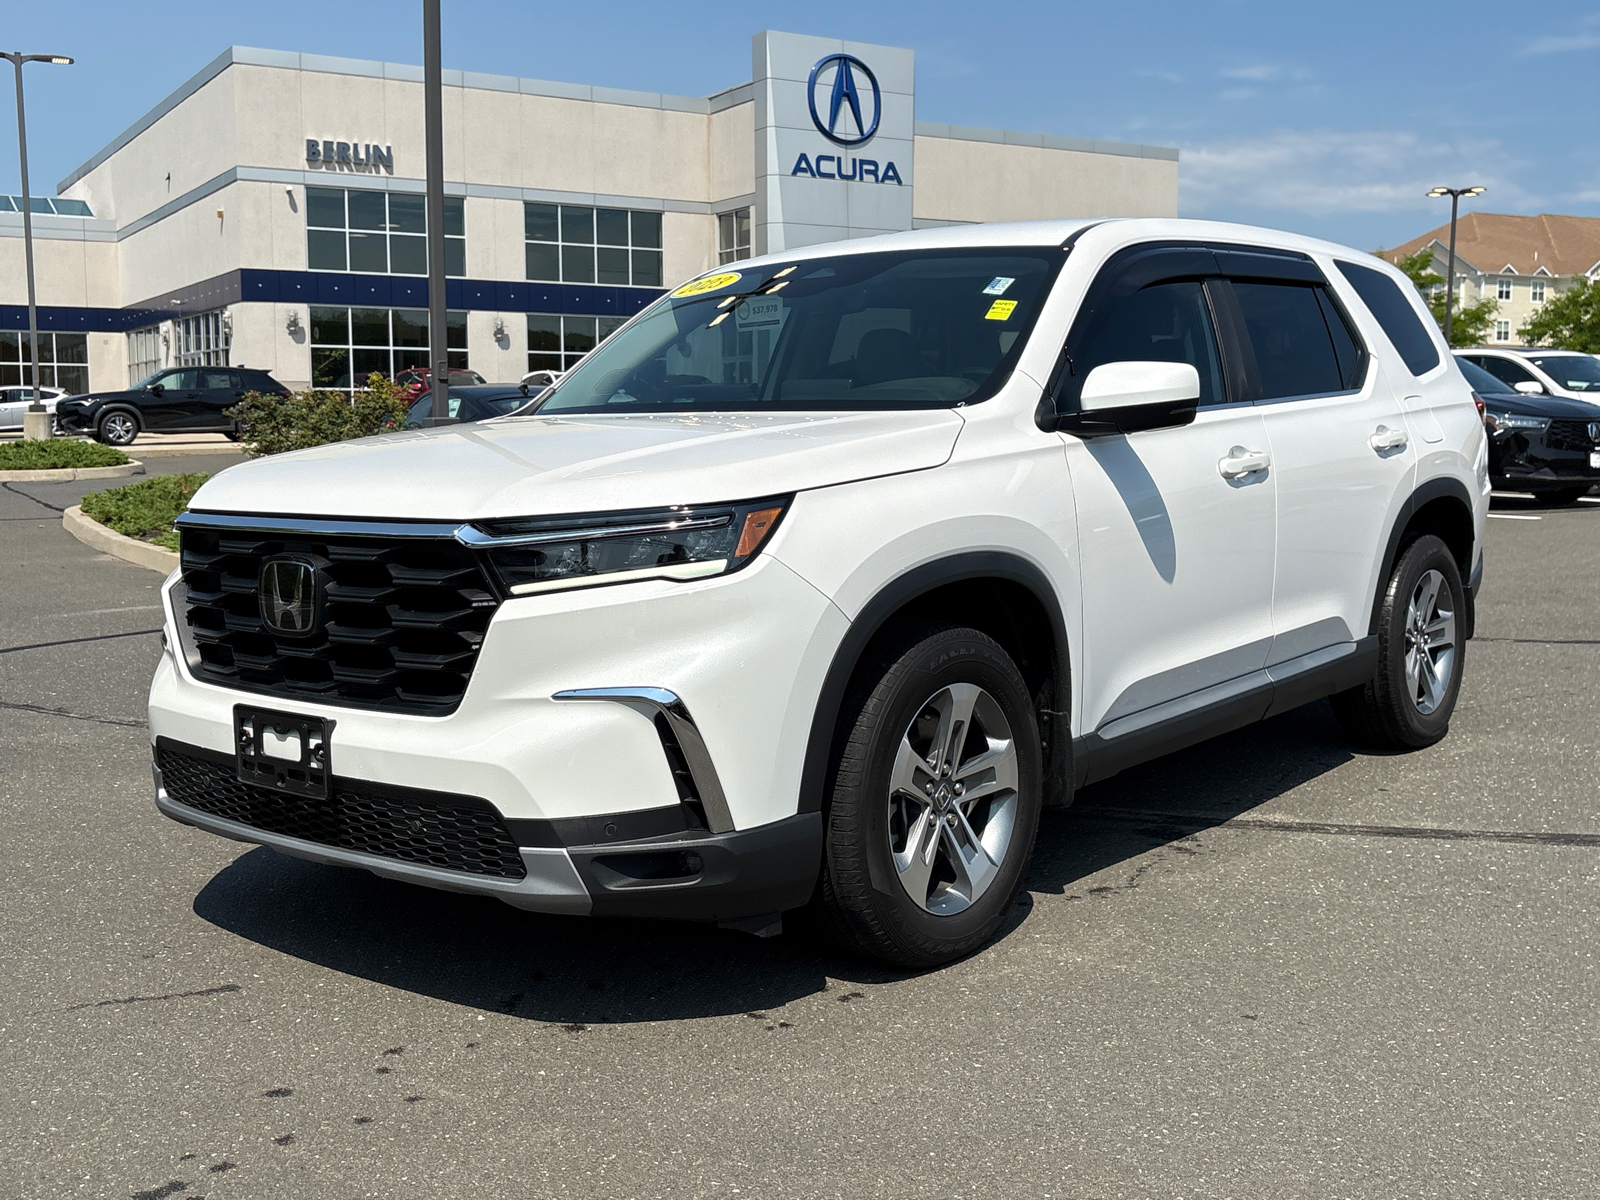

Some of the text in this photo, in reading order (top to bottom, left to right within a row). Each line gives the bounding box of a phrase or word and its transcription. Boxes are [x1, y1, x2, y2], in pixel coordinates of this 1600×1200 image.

[305, 138, 394, 168] BERLIN
[791, 152, 903, 187] ACURA
[752, 304, 778, 315] $37,978
[929, 646, 979, 671] EAGLE
